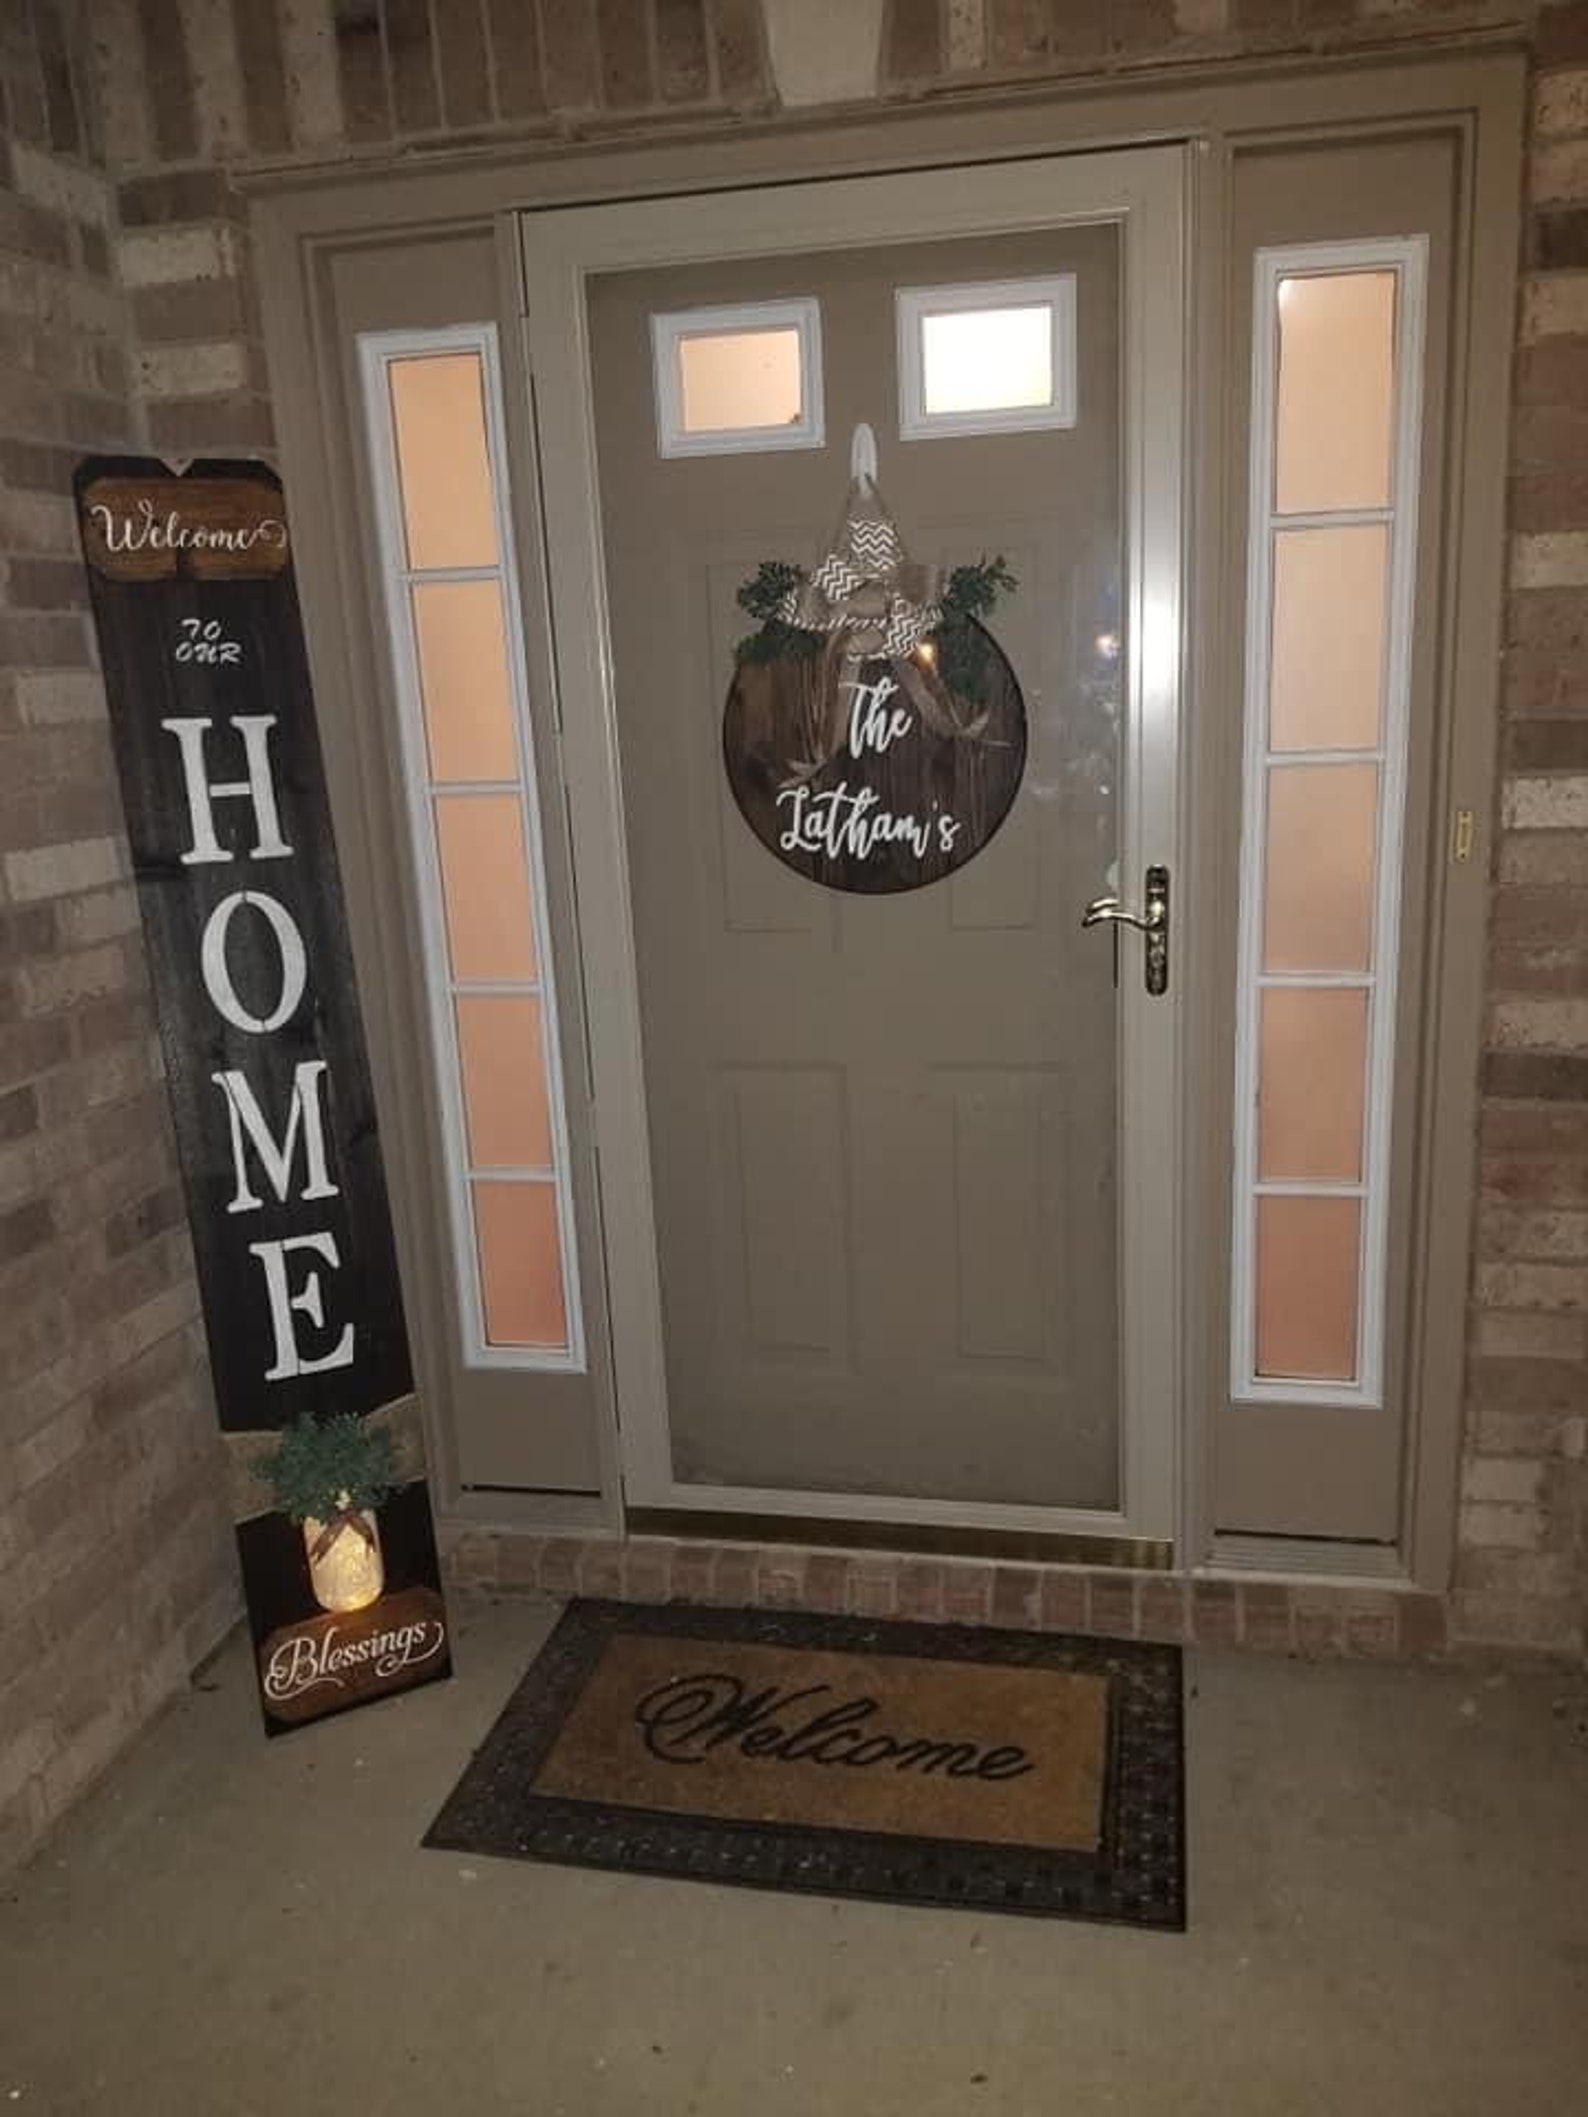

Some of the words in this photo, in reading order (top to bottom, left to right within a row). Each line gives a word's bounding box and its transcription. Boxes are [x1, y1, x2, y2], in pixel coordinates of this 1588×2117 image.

[91, 499, 287, 551] Welcome
[175, 642, 242, 664] OUR
[181, 618, 222, 640] TO
[776, 781, 962, 859] Latham's
[161, 715, 355, 1381] HOME
[264, 1621, 444, 1701] Blessings
[635, 1673, 1034, 1781] Welcome
